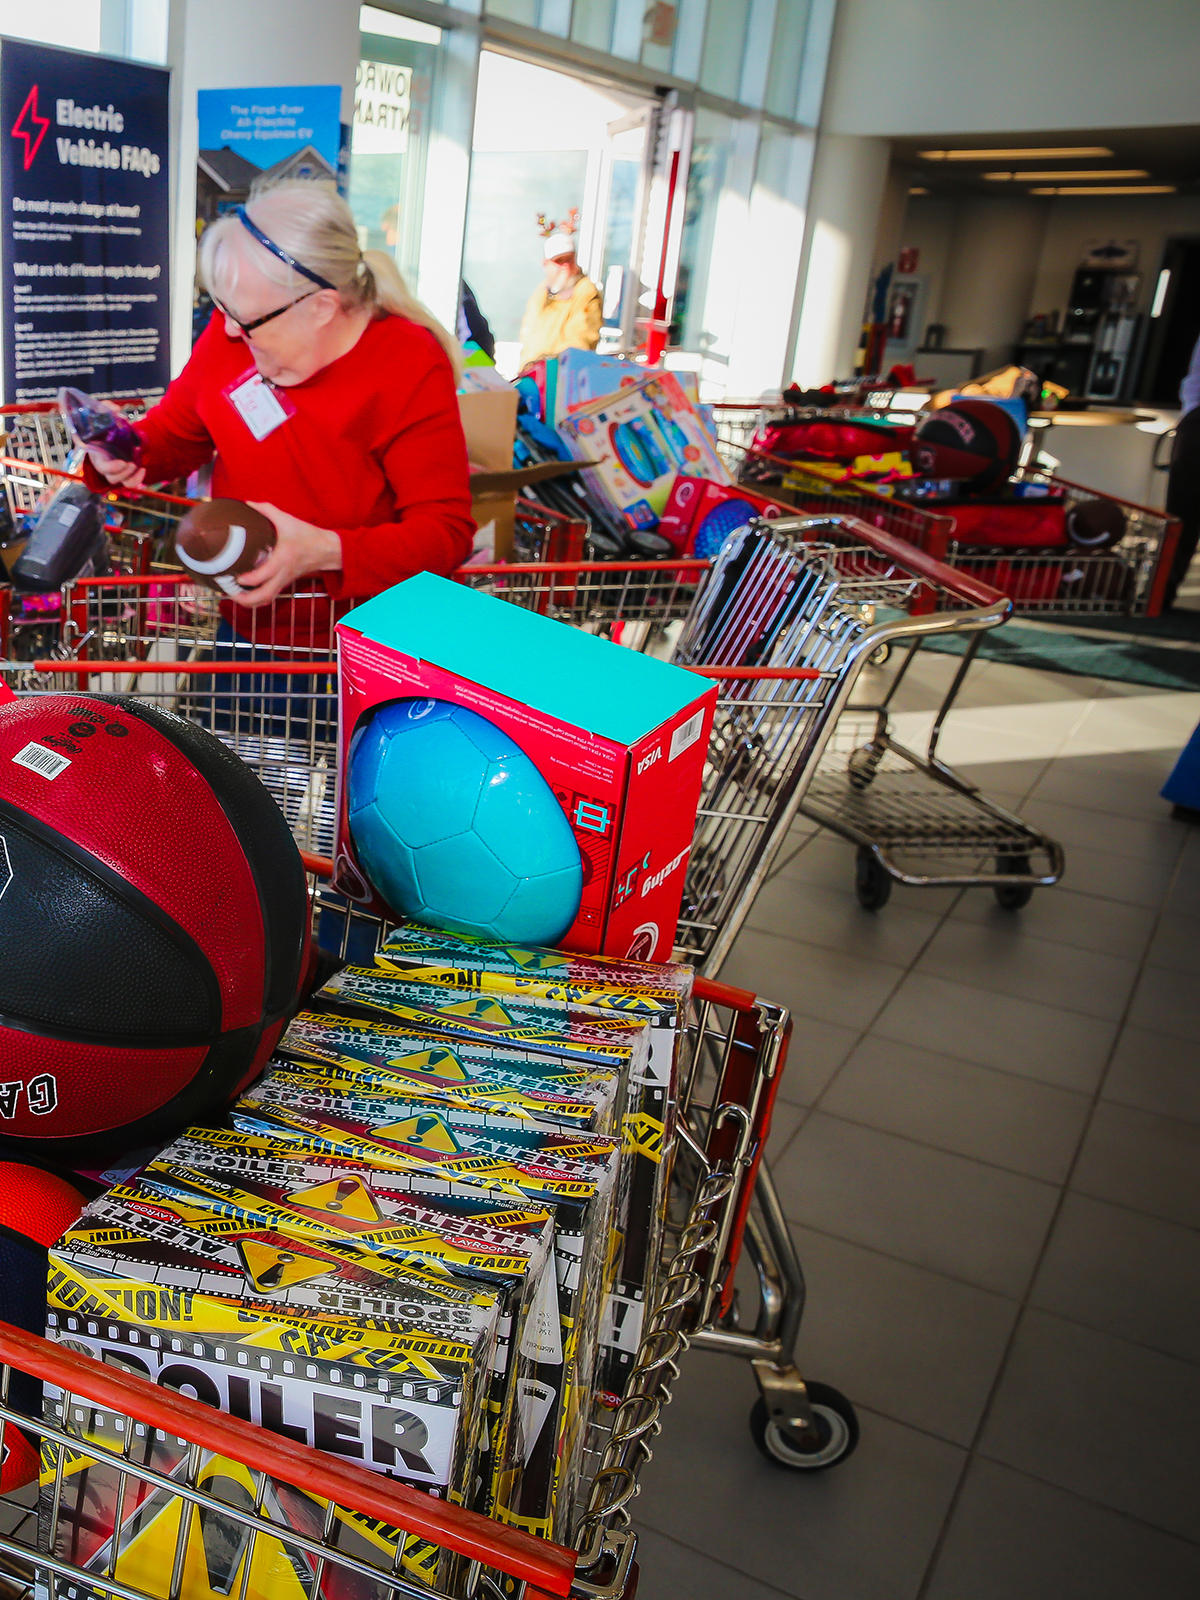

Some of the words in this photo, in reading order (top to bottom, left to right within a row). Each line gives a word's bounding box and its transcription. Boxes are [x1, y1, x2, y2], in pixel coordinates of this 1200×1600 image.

[56, 98, 124, 133] Electric
[231, 105, 249, 115] The
[56, 137, 121, 170] Vehicle
[121, 145, 161, 178] FAQs
[13, 197, 26, 211] Do
[27, 200, 50, 212] most
[50, 200, 77, 216] people
[13, 262, 38, 276] What
[637, 746, 663, 775] VISA
[343, 980, 450, 998] SPOILER
[263, 1091, 387, 1114] SPOILER
[173, 1149, 307, 1177] SPOILER
[101, 1203, 227, 1255] ALERT!
[392, 1206, 527, 1248] ALERT!
[315, 1290, 473, 1326] SPOILER
